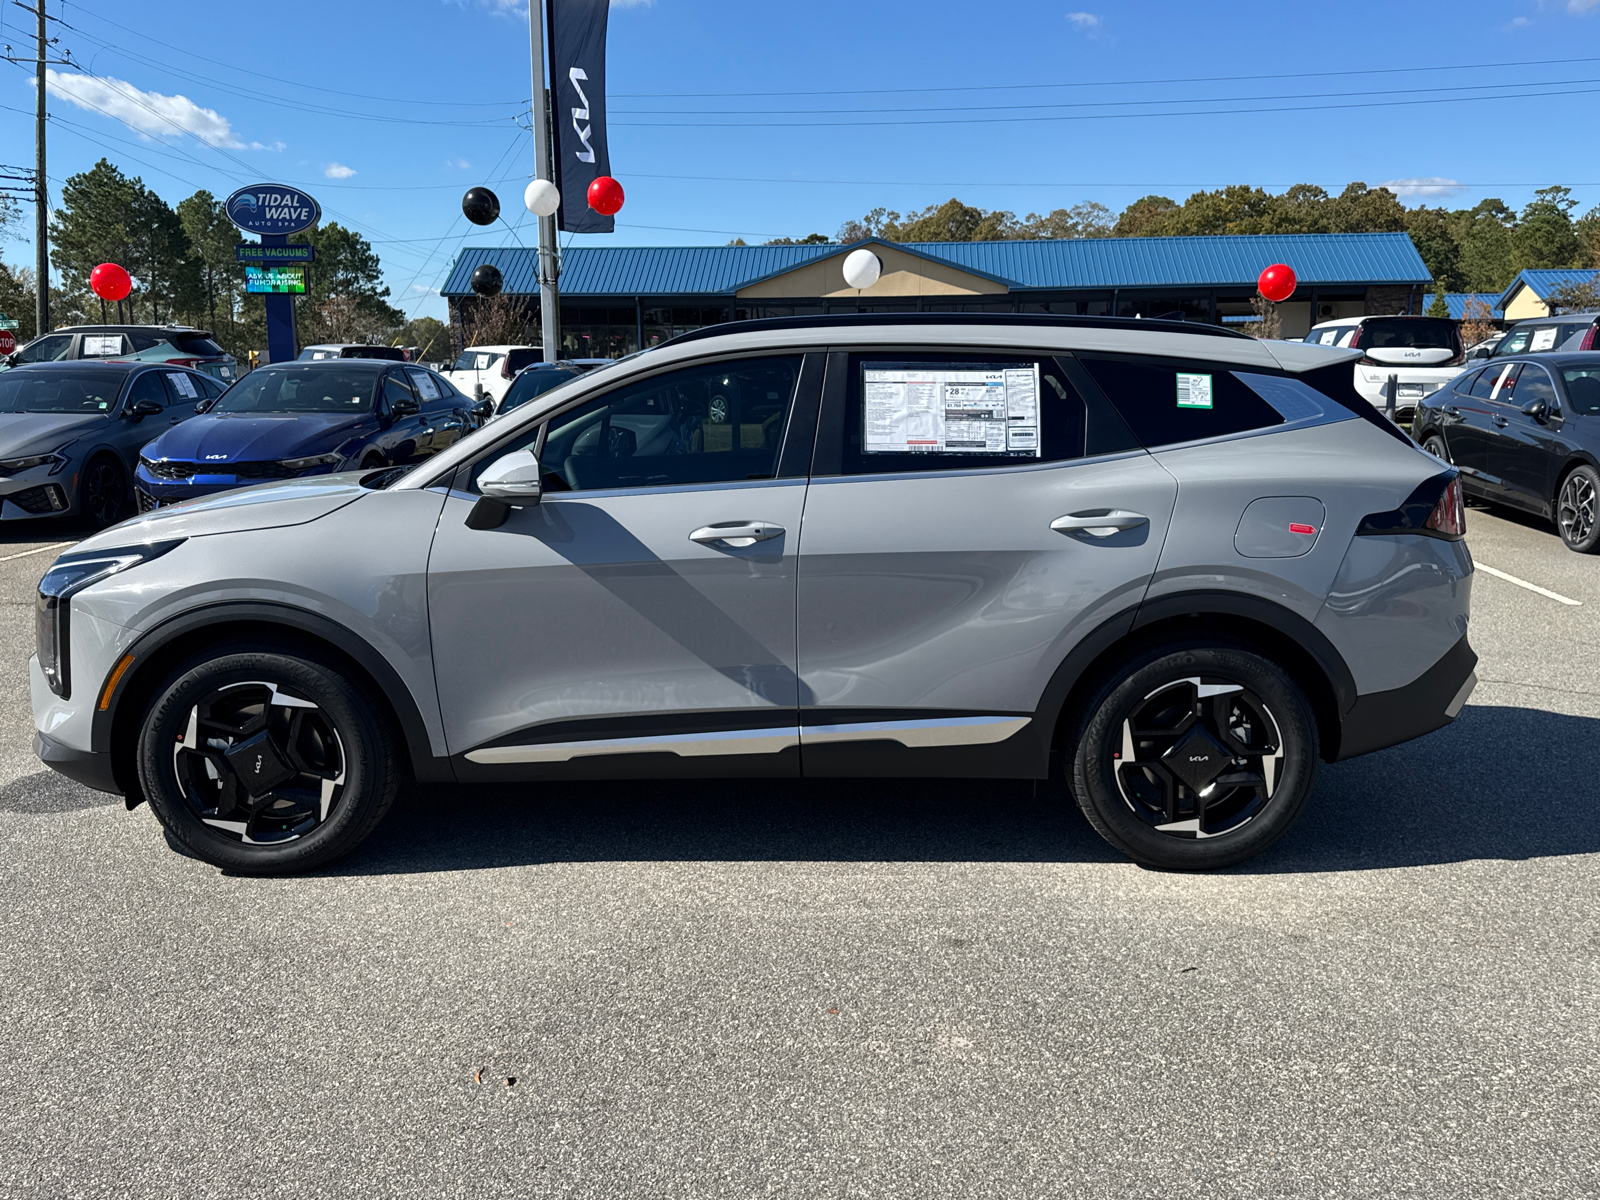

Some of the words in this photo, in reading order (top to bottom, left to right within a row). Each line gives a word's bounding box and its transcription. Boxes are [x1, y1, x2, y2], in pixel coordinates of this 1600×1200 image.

[569, 66, 596, 163] KIA
[257, 194, 300, 207] TIDAL
[265, 207, 309, 220] WAVE
[239, 247, 263, 257] FREE
[265, 247, 308, 257] VACUUMS
[1128, 653, 1196, 689] KUMHO
[151, 680, 192, 734] KUMHO
[254, 754, 263, 774] KIA
